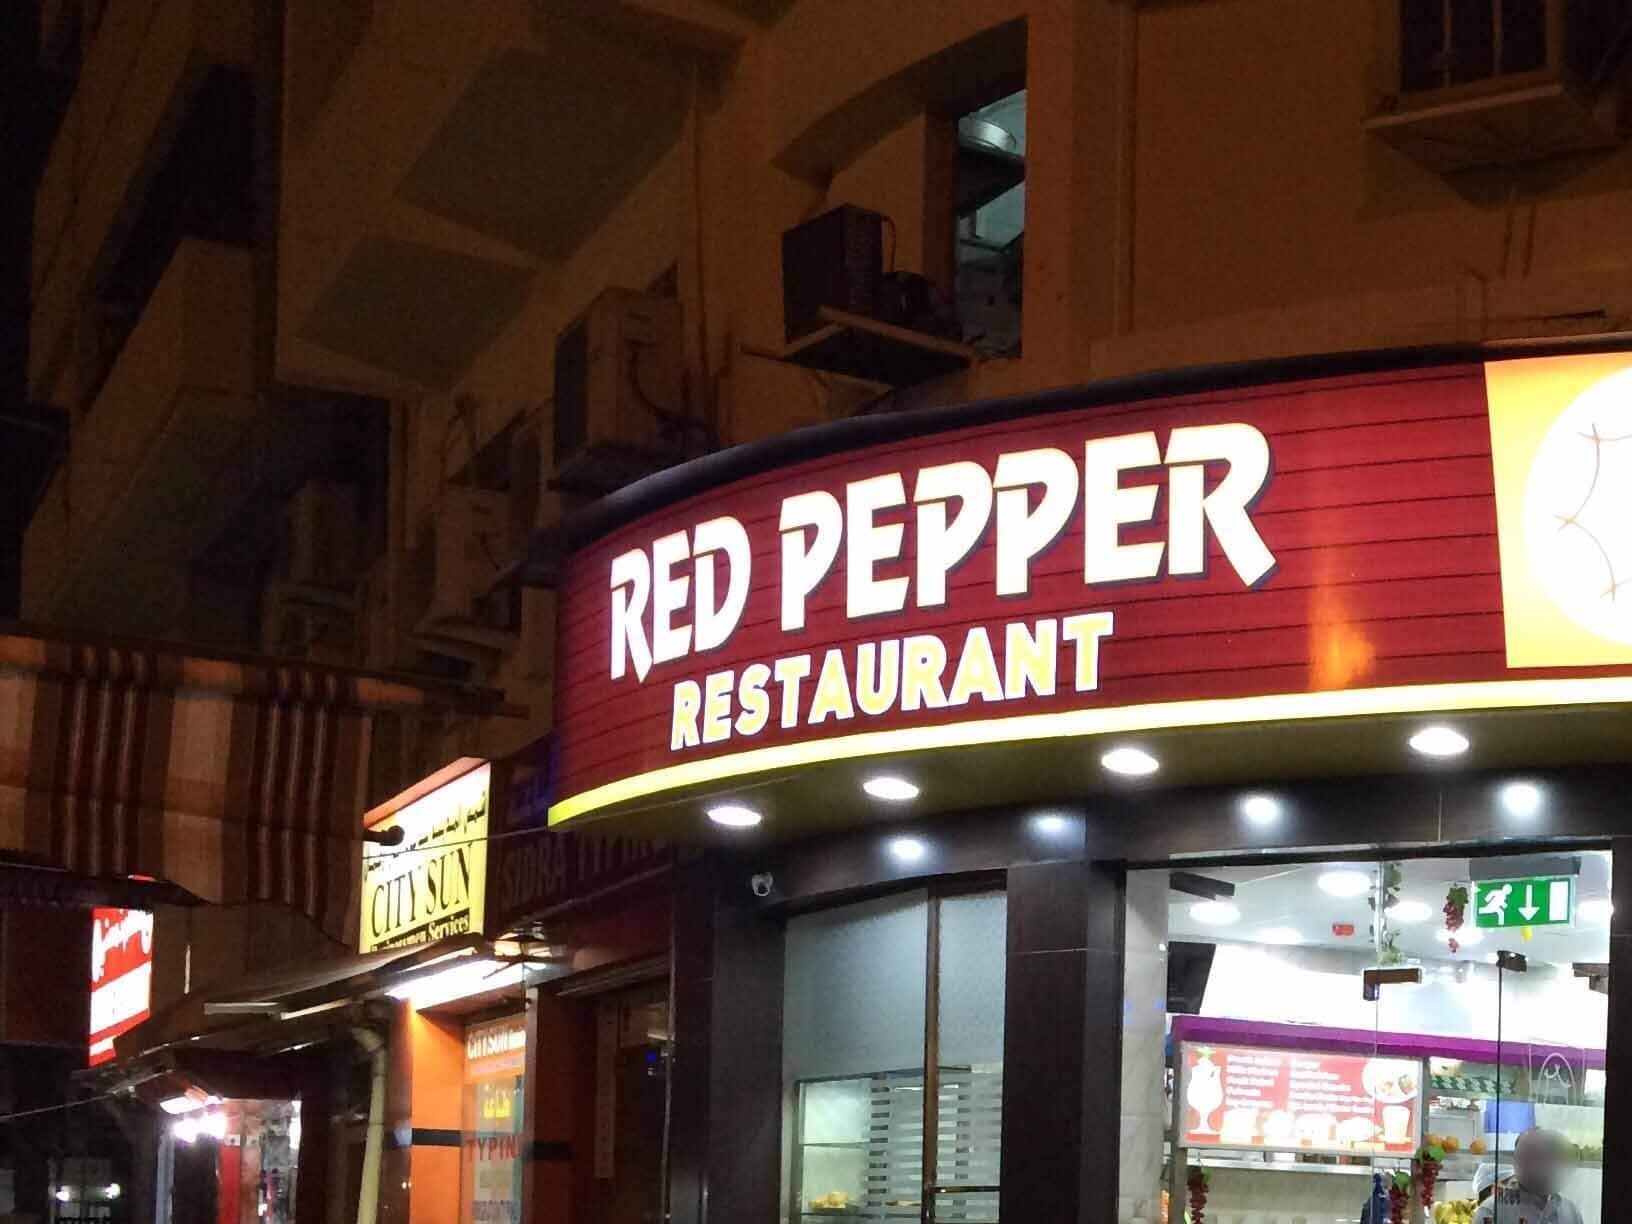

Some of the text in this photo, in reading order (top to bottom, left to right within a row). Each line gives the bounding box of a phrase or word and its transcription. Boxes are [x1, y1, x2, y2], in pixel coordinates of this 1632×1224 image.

[609, 421, 1278, 684] RED PEPPER
[670, 610, 1115, 752] RESTAURANT
[371, 866, 422, 938] CITY
[425, 842, 473, 916] SUN
